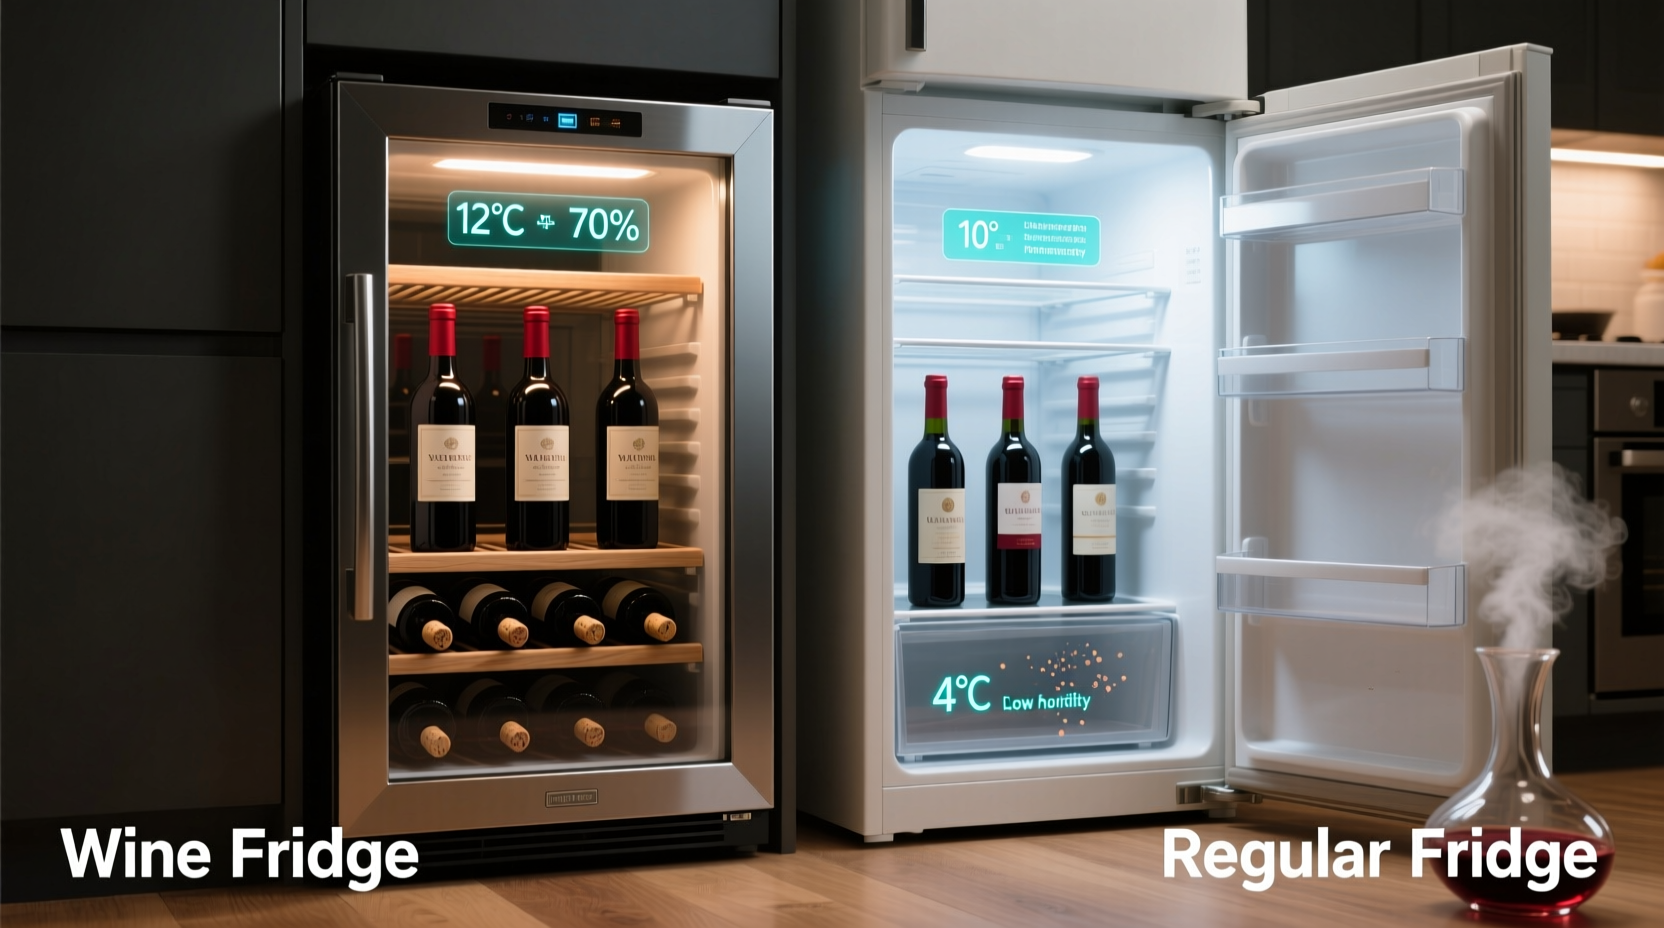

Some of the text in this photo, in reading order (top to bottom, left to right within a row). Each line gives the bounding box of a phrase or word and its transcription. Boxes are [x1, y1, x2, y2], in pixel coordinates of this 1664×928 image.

[456, 202, 524, 236] 12°C
[569, 207, 640, 241] 70%
[958, 219, 999, 249] 10°
[932, 675, 991, 712] 4°C
